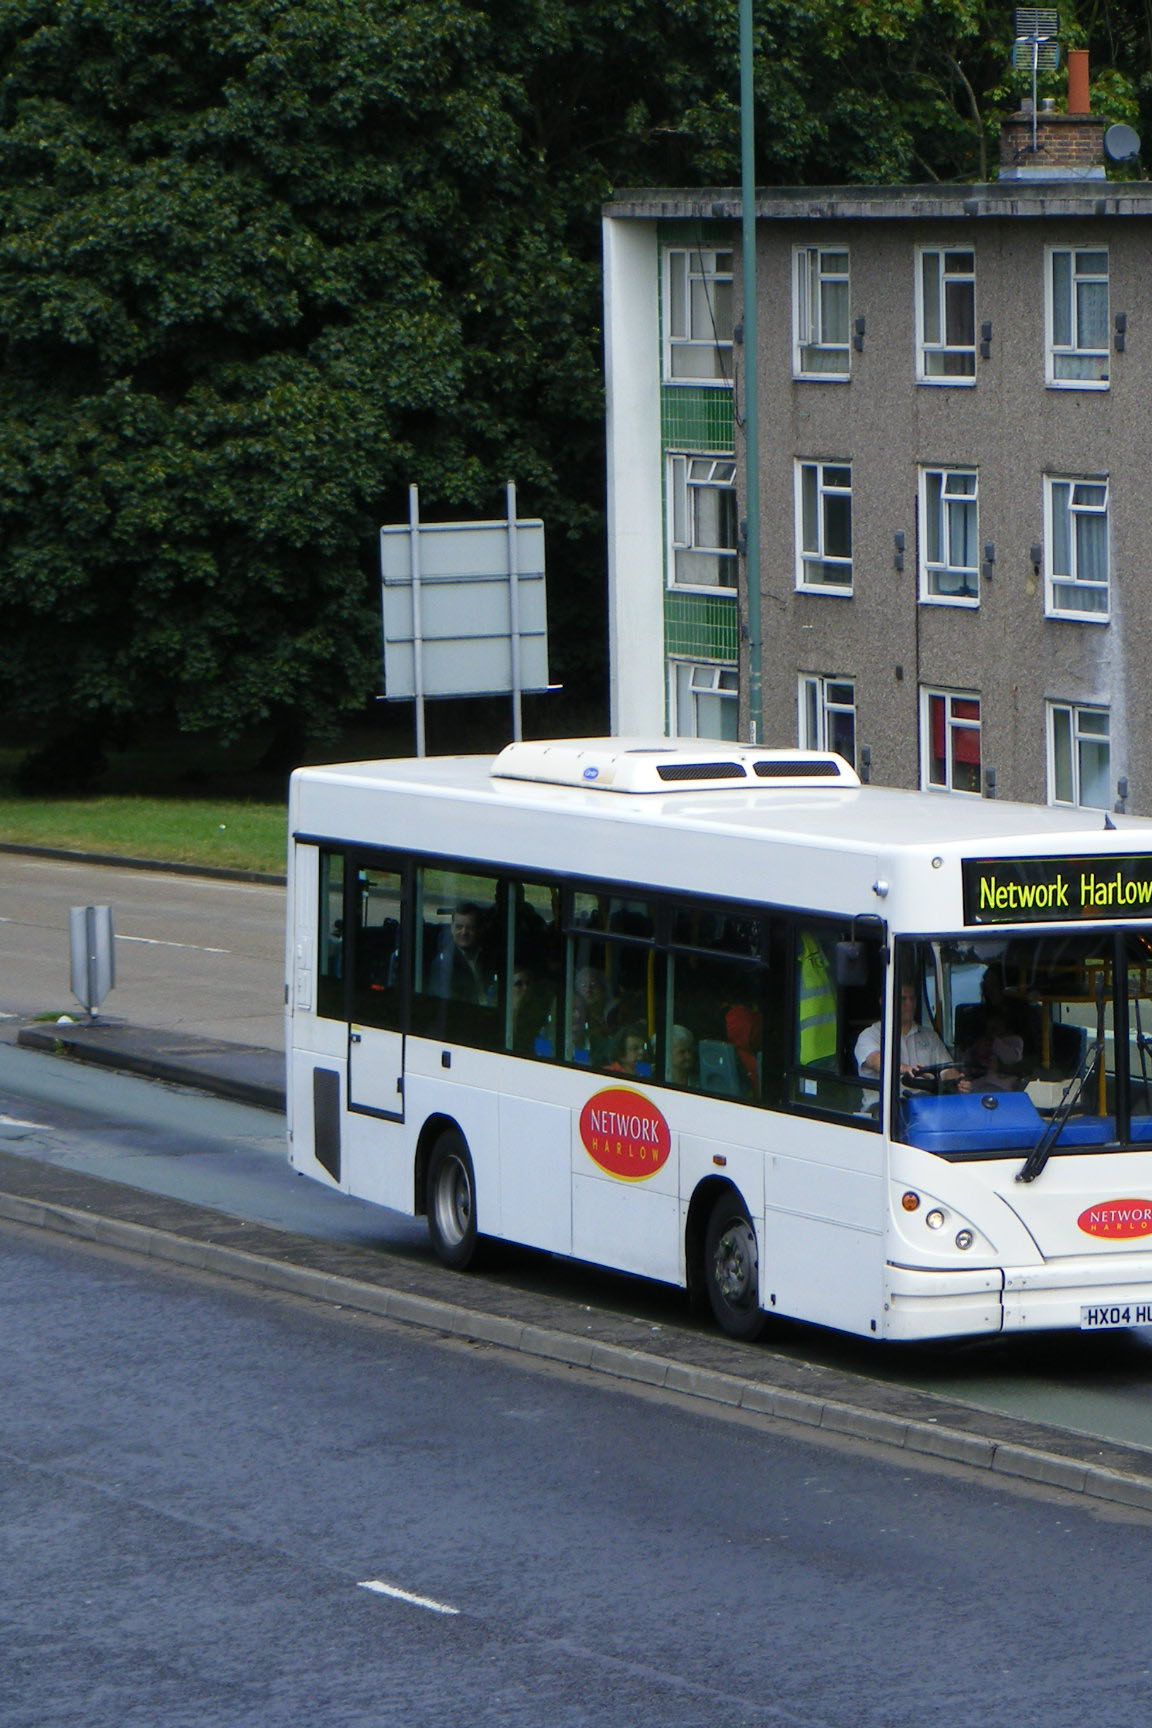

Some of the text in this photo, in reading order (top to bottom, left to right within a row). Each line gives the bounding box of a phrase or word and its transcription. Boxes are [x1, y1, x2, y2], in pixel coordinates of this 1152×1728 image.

[979, 873, 1069, 909] Network
[591, 1109, 659, 1143] NETWORK
[592, 1138, 659, 1161] HARLOW
[1088, 1307, 1131, 1325] HX04
